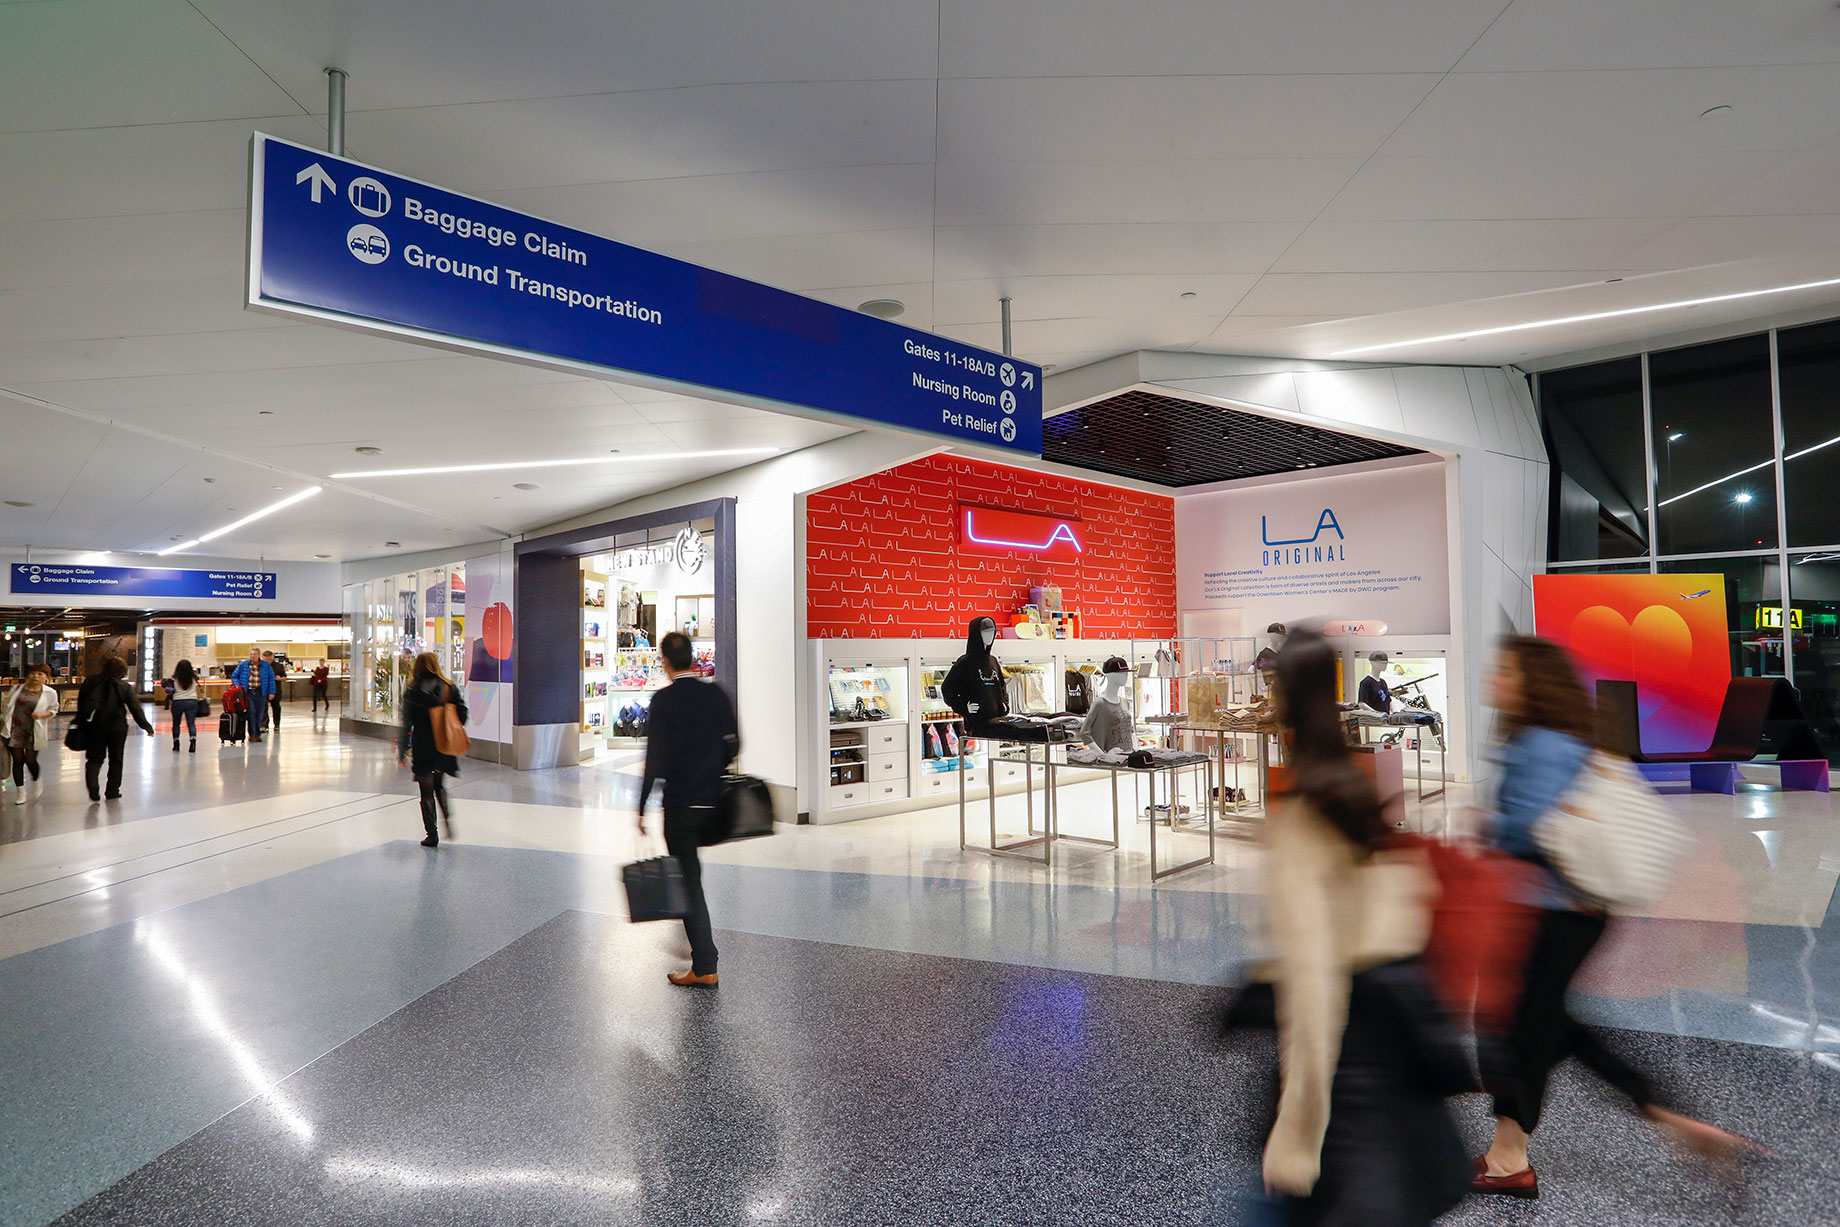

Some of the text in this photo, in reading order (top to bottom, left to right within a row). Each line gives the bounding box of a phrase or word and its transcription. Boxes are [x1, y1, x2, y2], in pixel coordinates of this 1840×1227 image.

[404, 197, 588, 266] Baggage Claim
[403, 244, 662, 325] Ground Transportation
[904, 338, 996, 377] Gates 11-18A/B
[912, 372, 996, 406] Nursing Room
[942, 409, 998, 434] Pet Relief
[967, 510, 1083, 553] LA
[1262, 508, 1345, 546] LA
[1262, 544, 1346, 566] ORIGINAL
[1228, 592, 1246, 600] support
[1764, 610, 1800, 628] 11A
